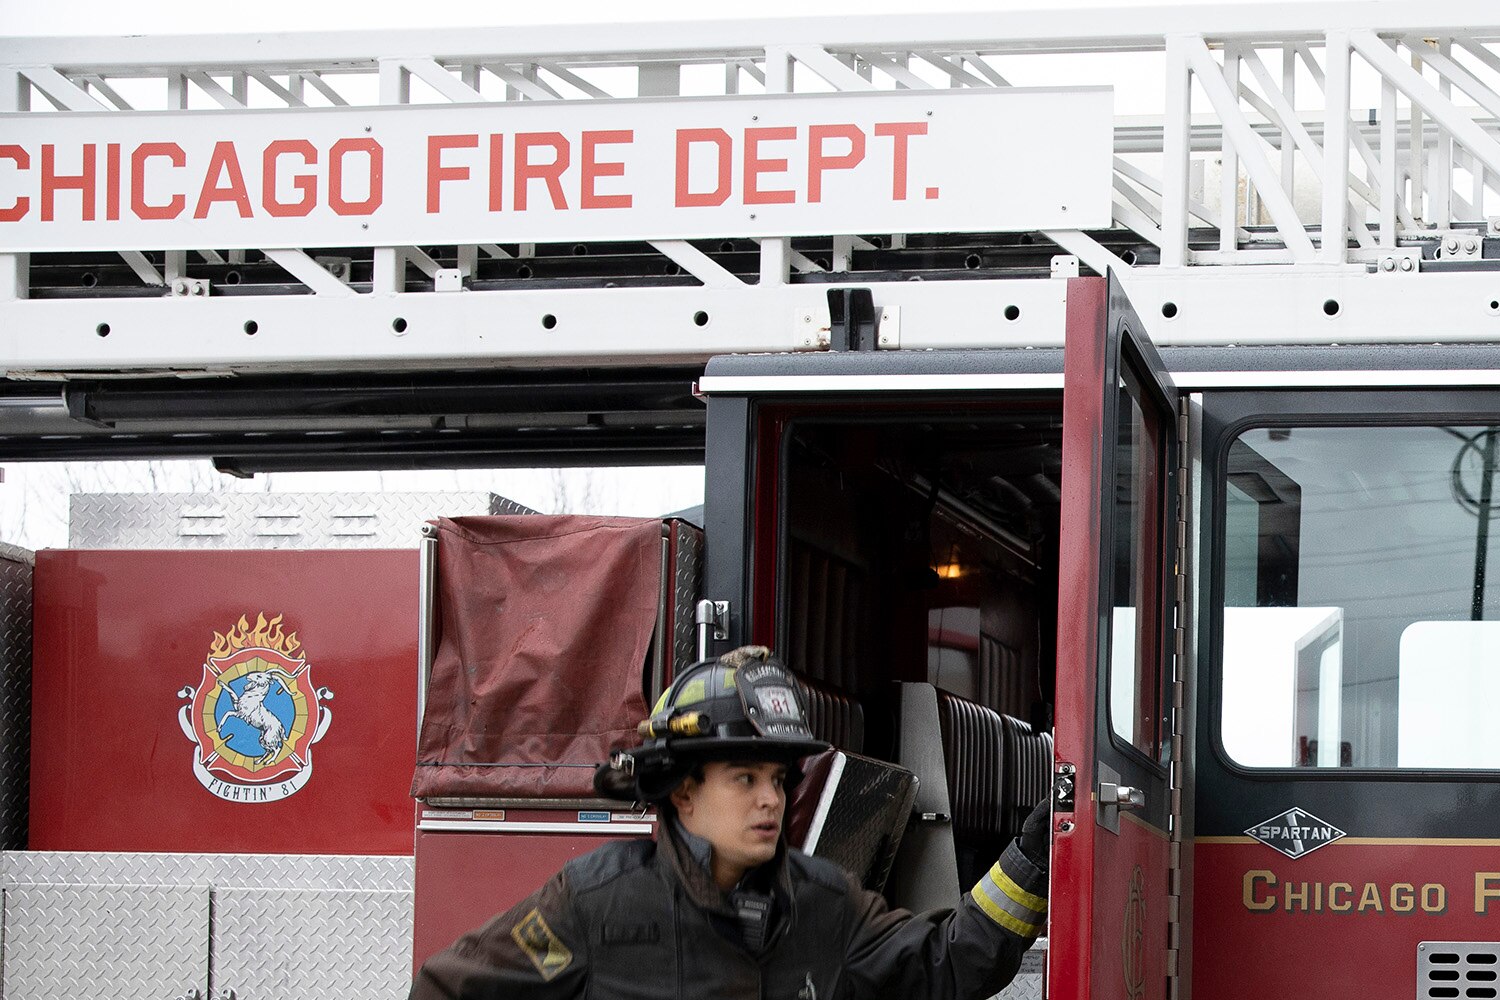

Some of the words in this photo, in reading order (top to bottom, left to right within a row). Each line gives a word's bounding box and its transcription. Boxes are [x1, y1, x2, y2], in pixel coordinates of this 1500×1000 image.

[0, 137, 384, 223] CHICAGO
[426, 129, 634, 214] FIRE
[675, 122, 939, 208] DEPT.
[772, 698, 791, 714] 81
[282, 780, 297, 795] 81
[1259, 826, 1332, 840] SPARTAN
